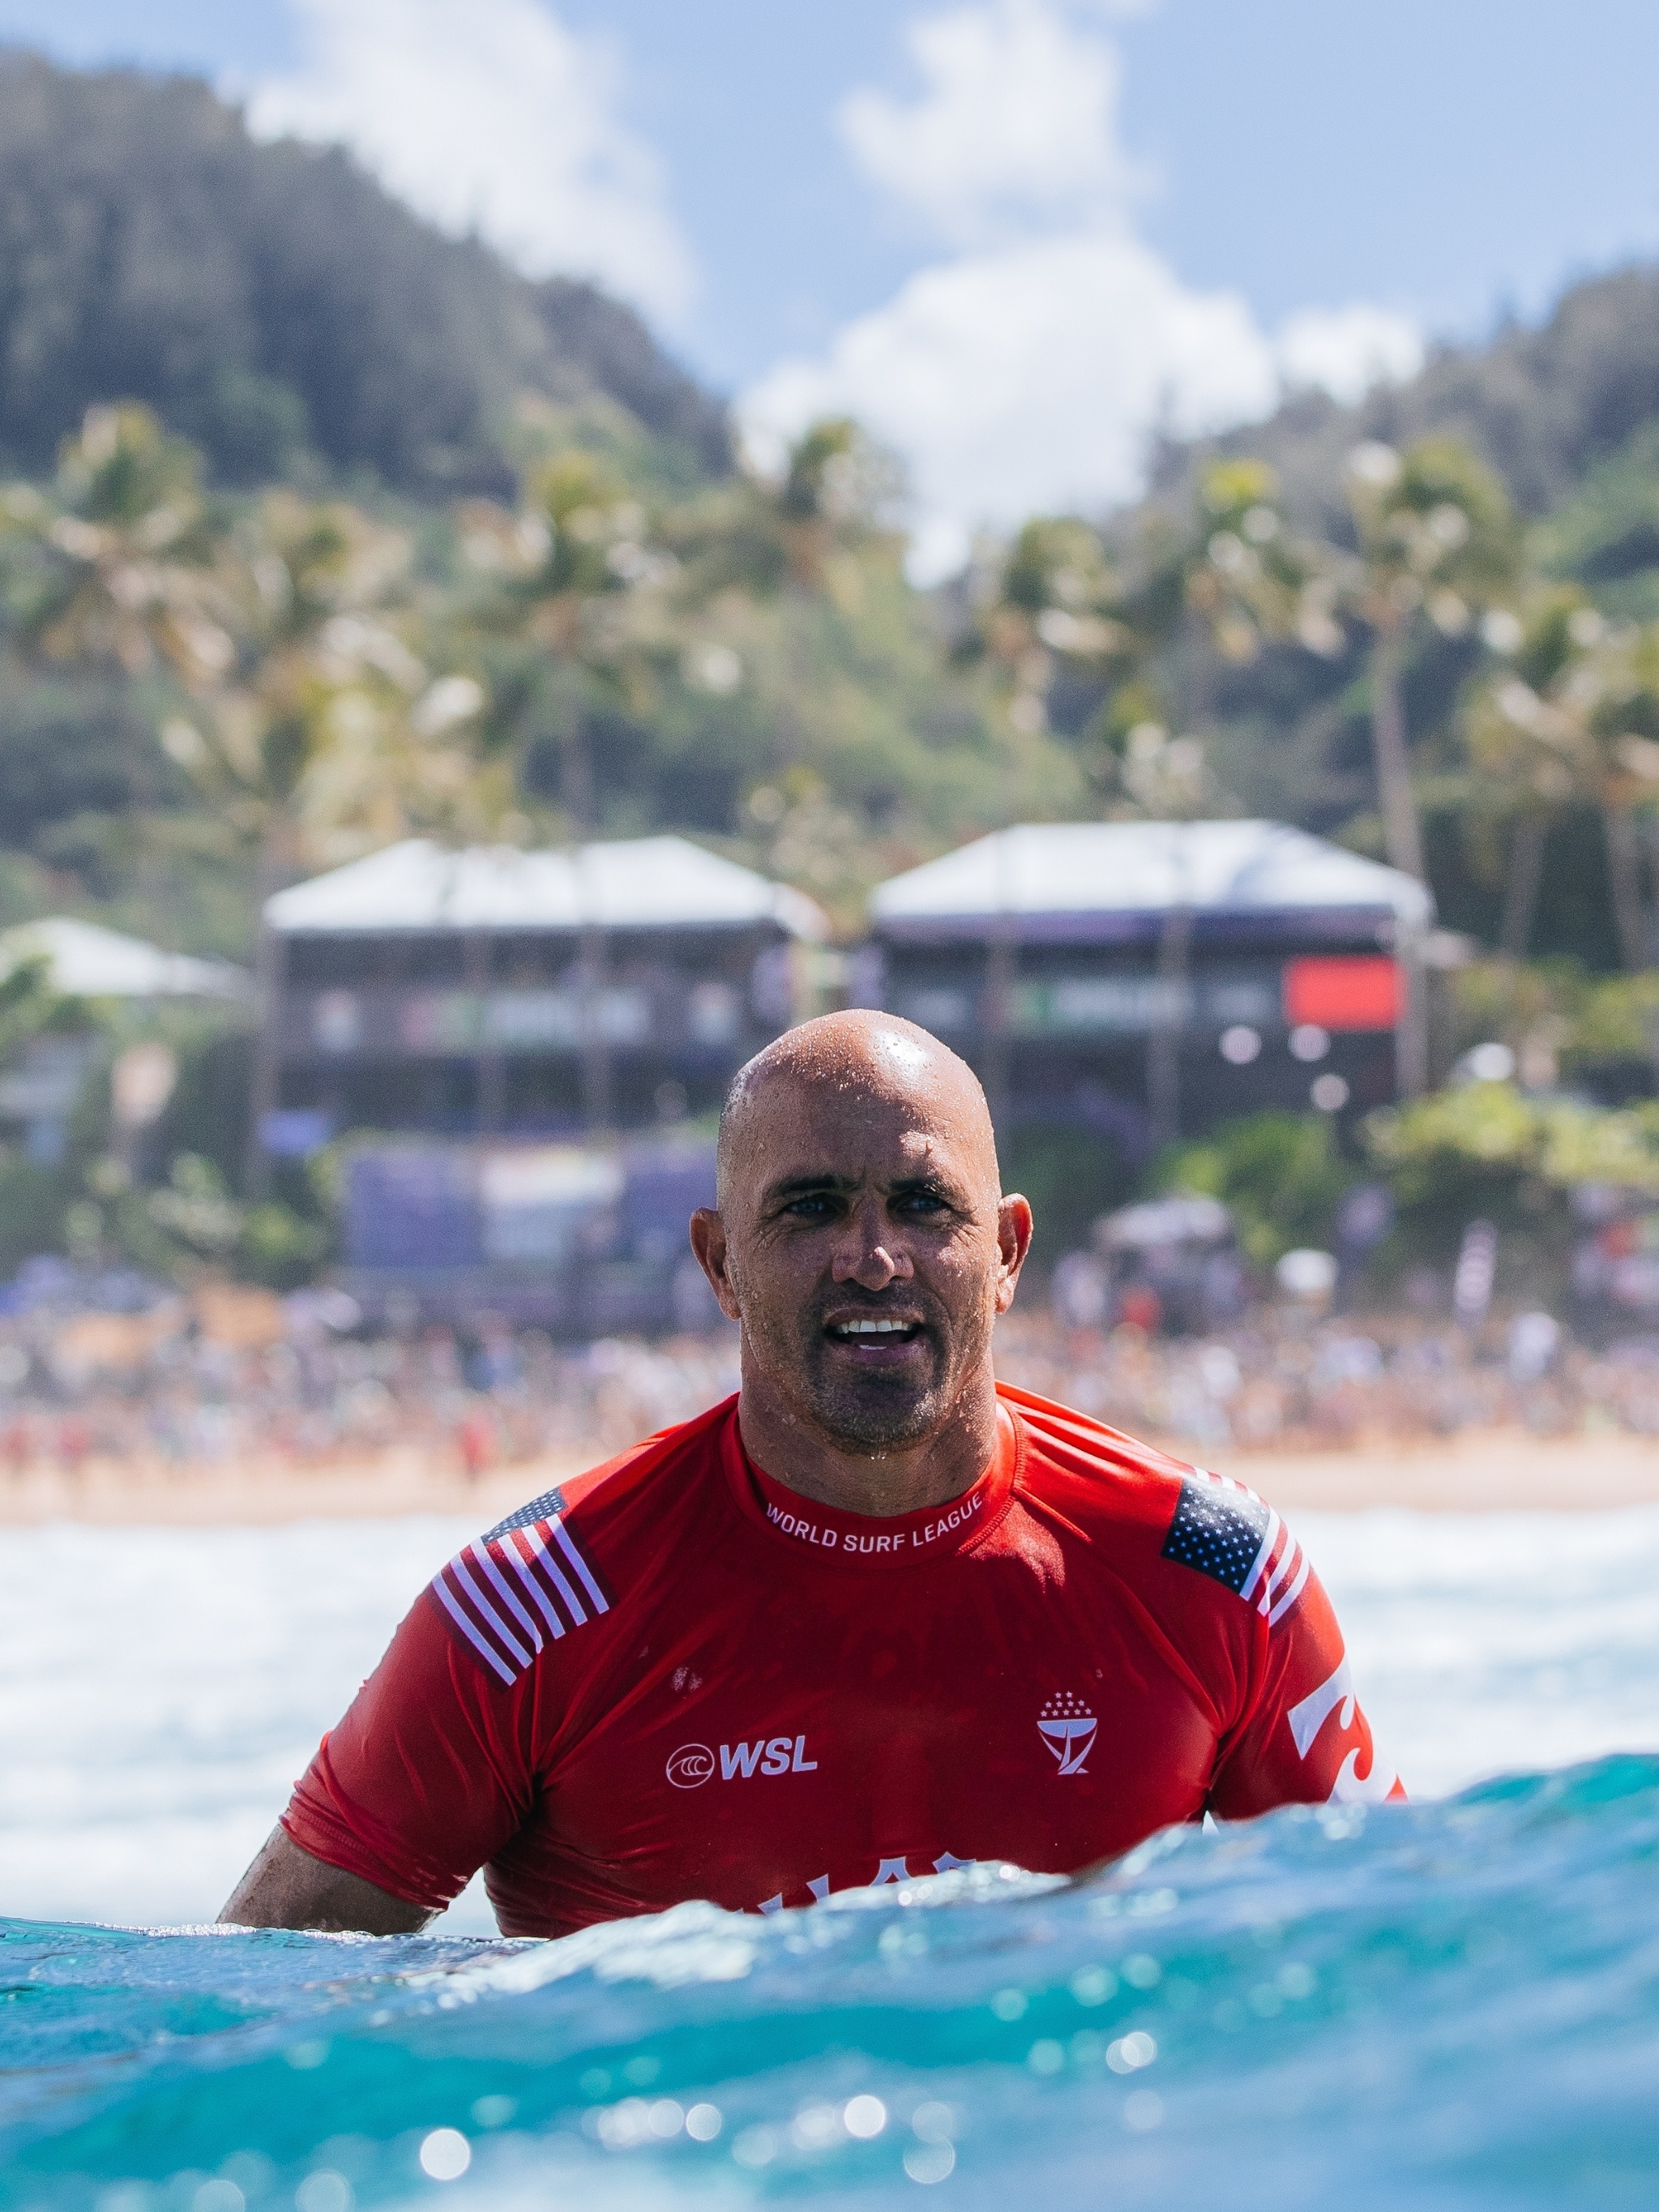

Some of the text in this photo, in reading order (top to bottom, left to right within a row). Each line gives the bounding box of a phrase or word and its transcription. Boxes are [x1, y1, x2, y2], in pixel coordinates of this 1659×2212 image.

[767, 1492, 983, 1553] WORLD SURF LEAGUE
[720, 1735, 818, 1780] WSL
